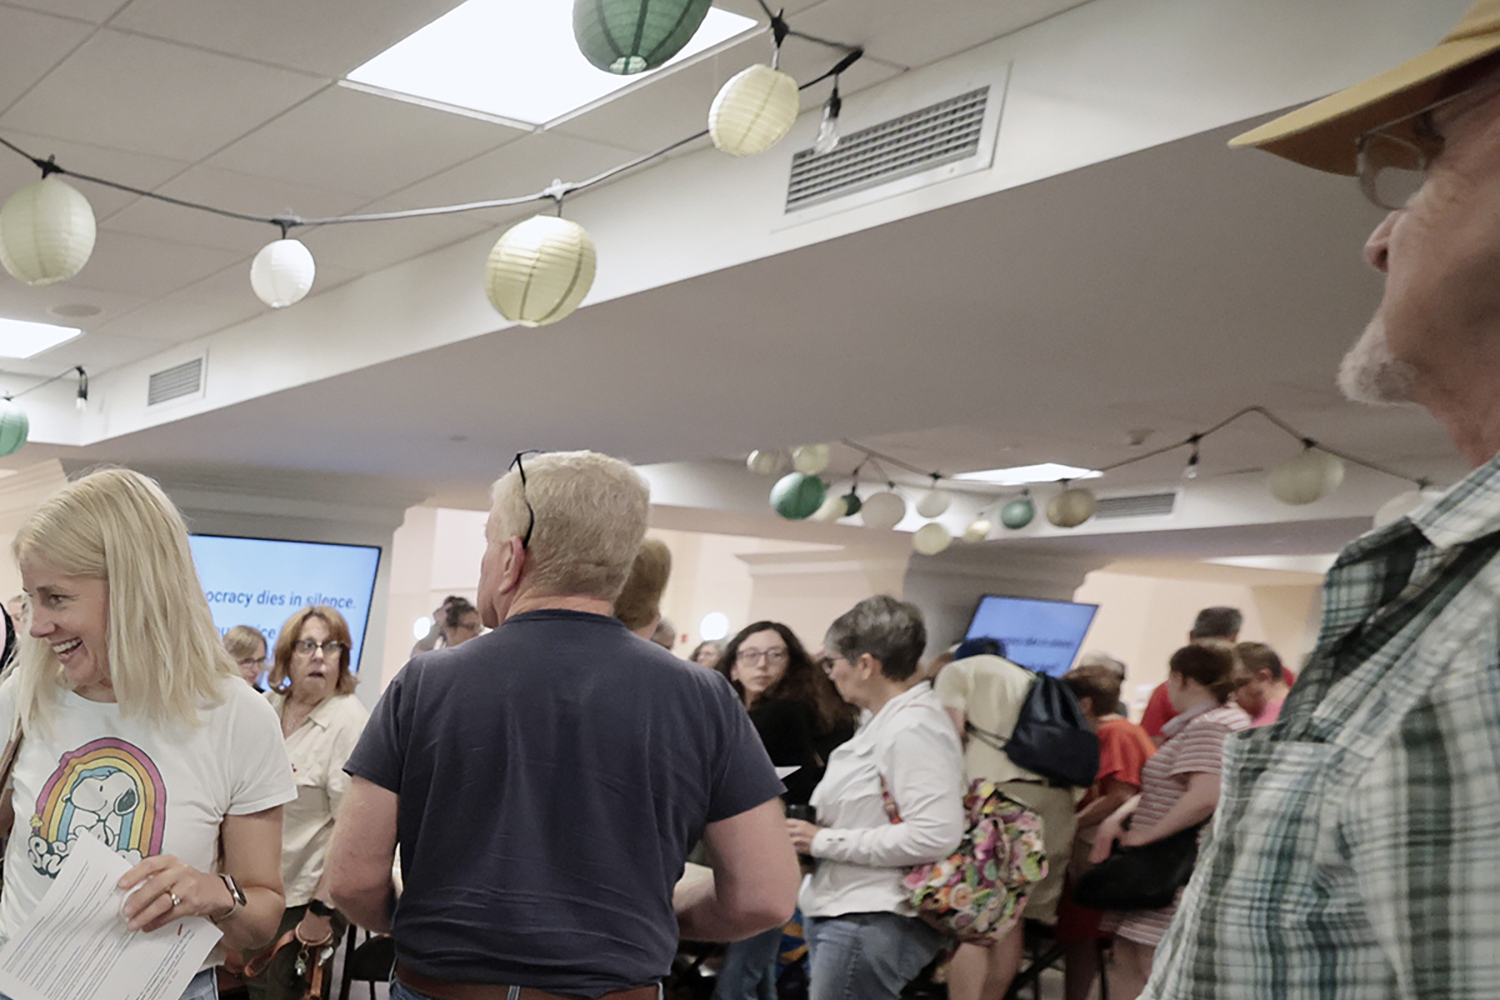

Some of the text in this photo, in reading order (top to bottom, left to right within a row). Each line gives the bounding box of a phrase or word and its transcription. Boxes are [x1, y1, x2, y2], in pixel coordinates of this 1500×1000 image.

[206, 590, 254, 608] ocracy
[256, 590, 285, 606] dies
[289, 591, 303, 606] in
